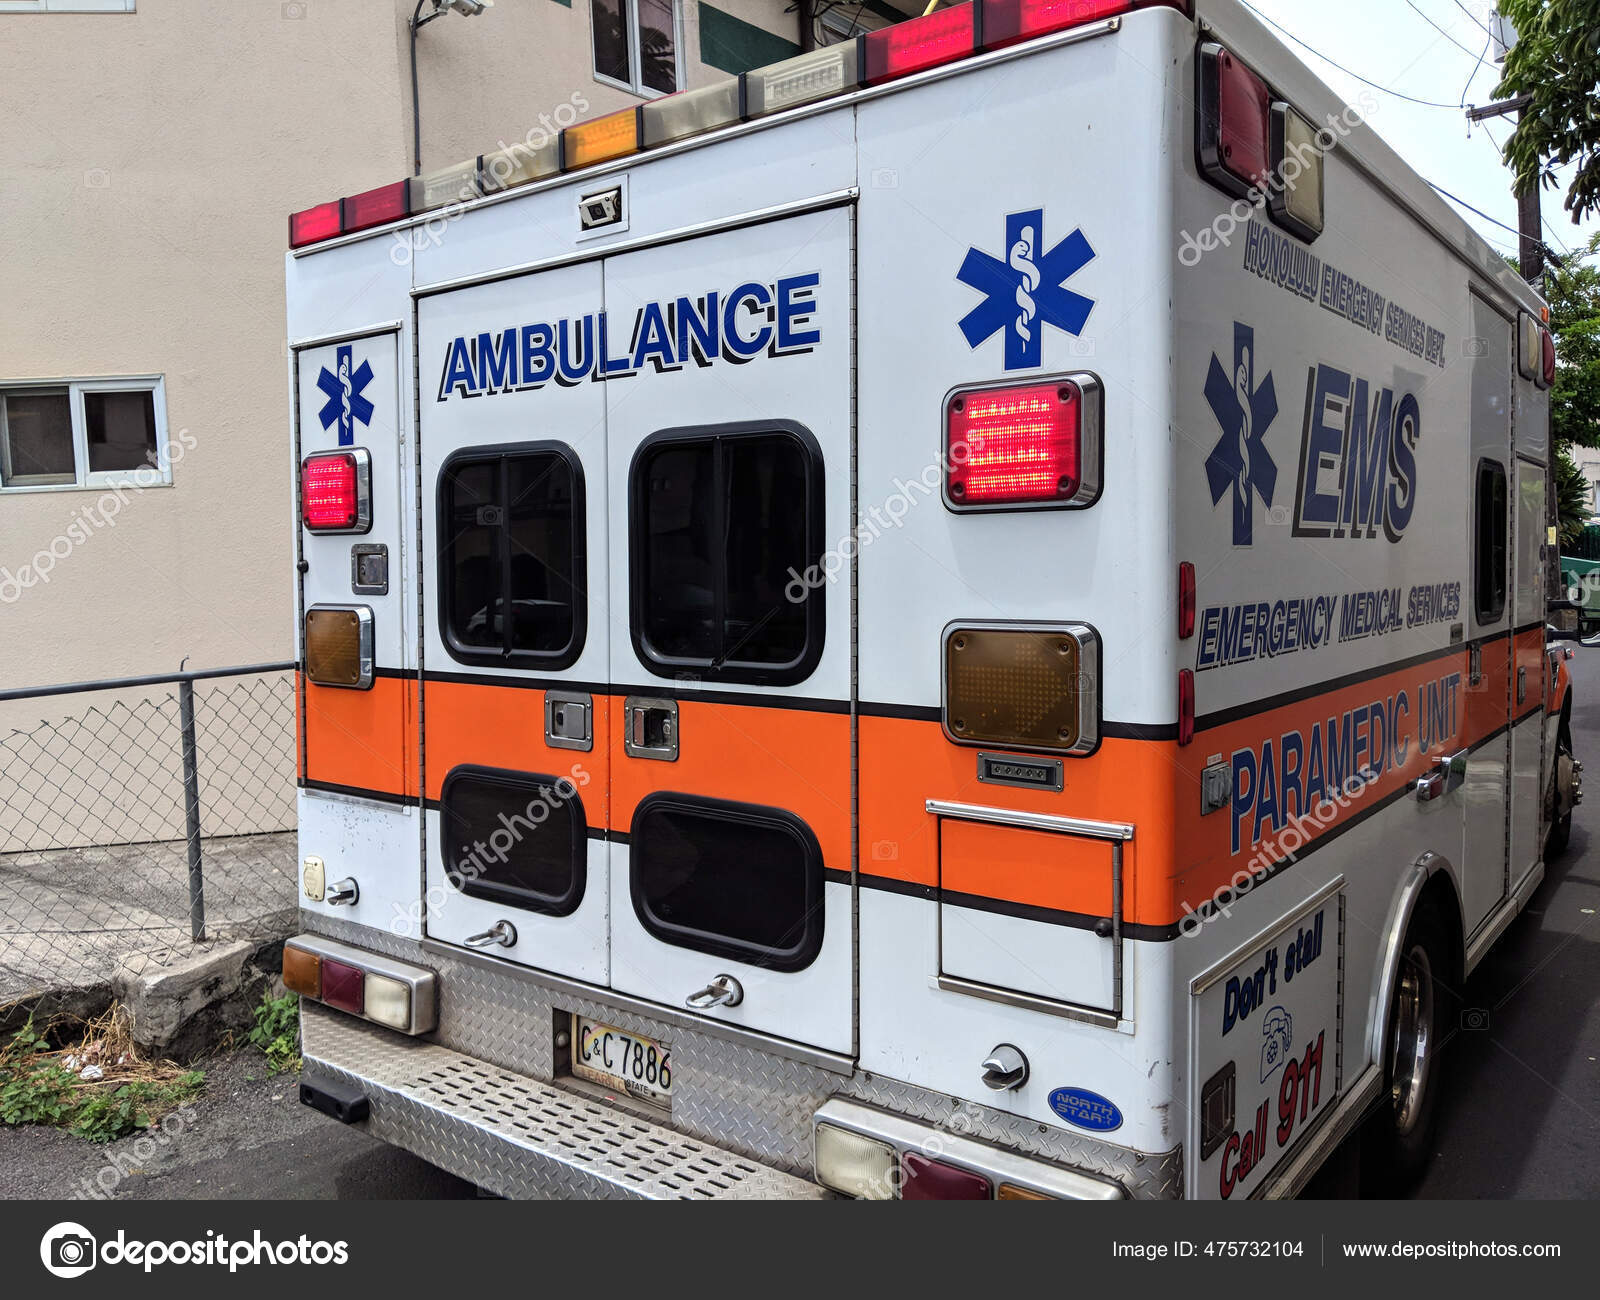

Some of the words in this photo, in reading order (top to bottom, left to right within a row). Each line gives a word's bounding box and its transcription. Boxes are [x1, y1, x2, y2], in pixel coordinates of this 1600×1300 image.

[437, 271, 821, 402] AMBULANCE
[1243, 218, 1321, 303] HONOLULU
[1320, 263, 1386, 336] EMERGENCY
[1385, 301, 1426, 358] SERVICES
[1425, 325, 1446, 368] DEPT.
[1291, 363, 1421, 543] EMS
[1196, 595, 1338, 672] EMERGENCY
[1339, 588, 1404, 644] MEDICAL
[1406, 581, 1461, 629] SERVICES
[1230, 689, 1410, 856] PARAMEDIC
[1418, 672, 1462, 755] UNIT
[1222, 946, 1279, 1037] Don't
[1284, 910, 1324, 983] stall
[625, 1079, 649, 1096] STATE
[1056, 1092, 1113, 1116] NORTH
[1220, 1097, 1270, 1200] Call
[1277, 1029, 1325, 1148] 911
